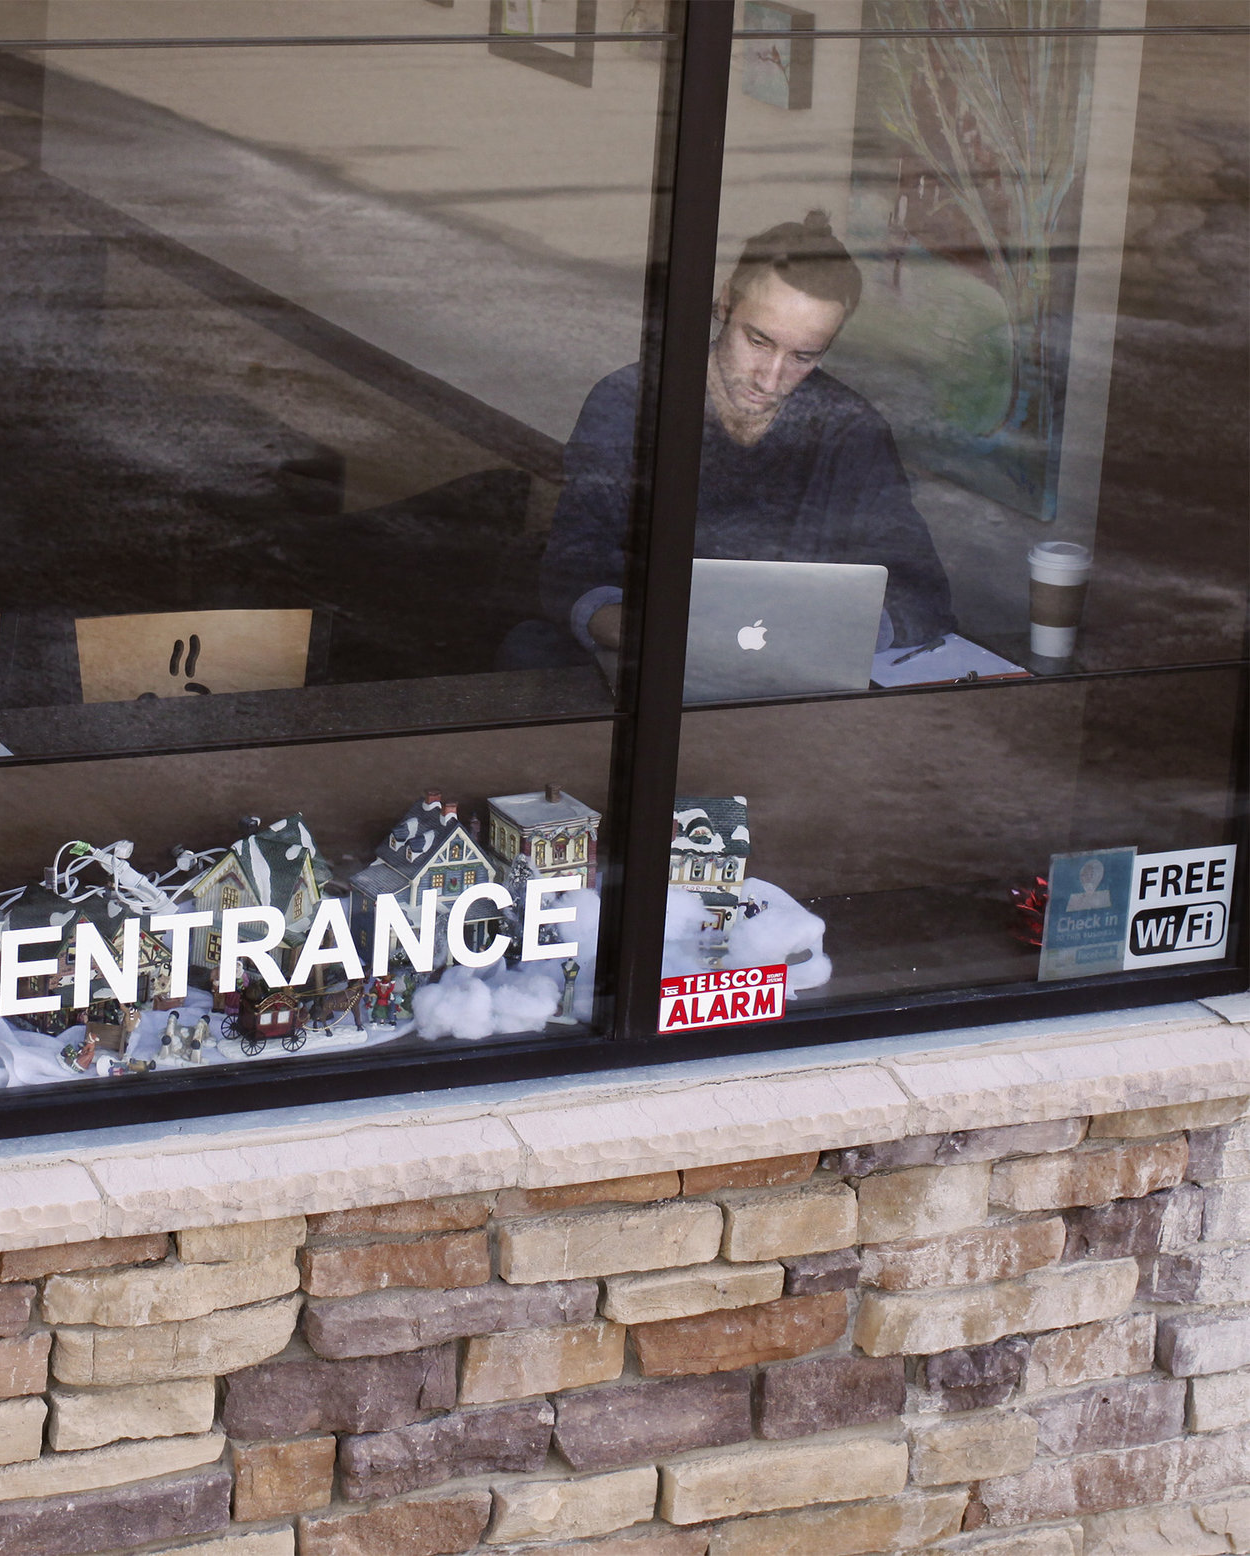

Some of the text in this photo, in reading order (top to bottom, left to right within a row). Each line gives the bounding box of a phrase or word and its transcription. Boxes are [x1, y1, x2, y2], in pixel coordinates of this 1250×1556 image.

[1138, 858, 1227, 900] FREE
[1056, 911, 1119, 933] Check in
[1136, 910, 1214, 950] WiFi
[0, 874, 582, 1017] ENTRANCE
[683, 968, 763, 994] TELSCO
[666, 988, 775, 1027] ALARM
